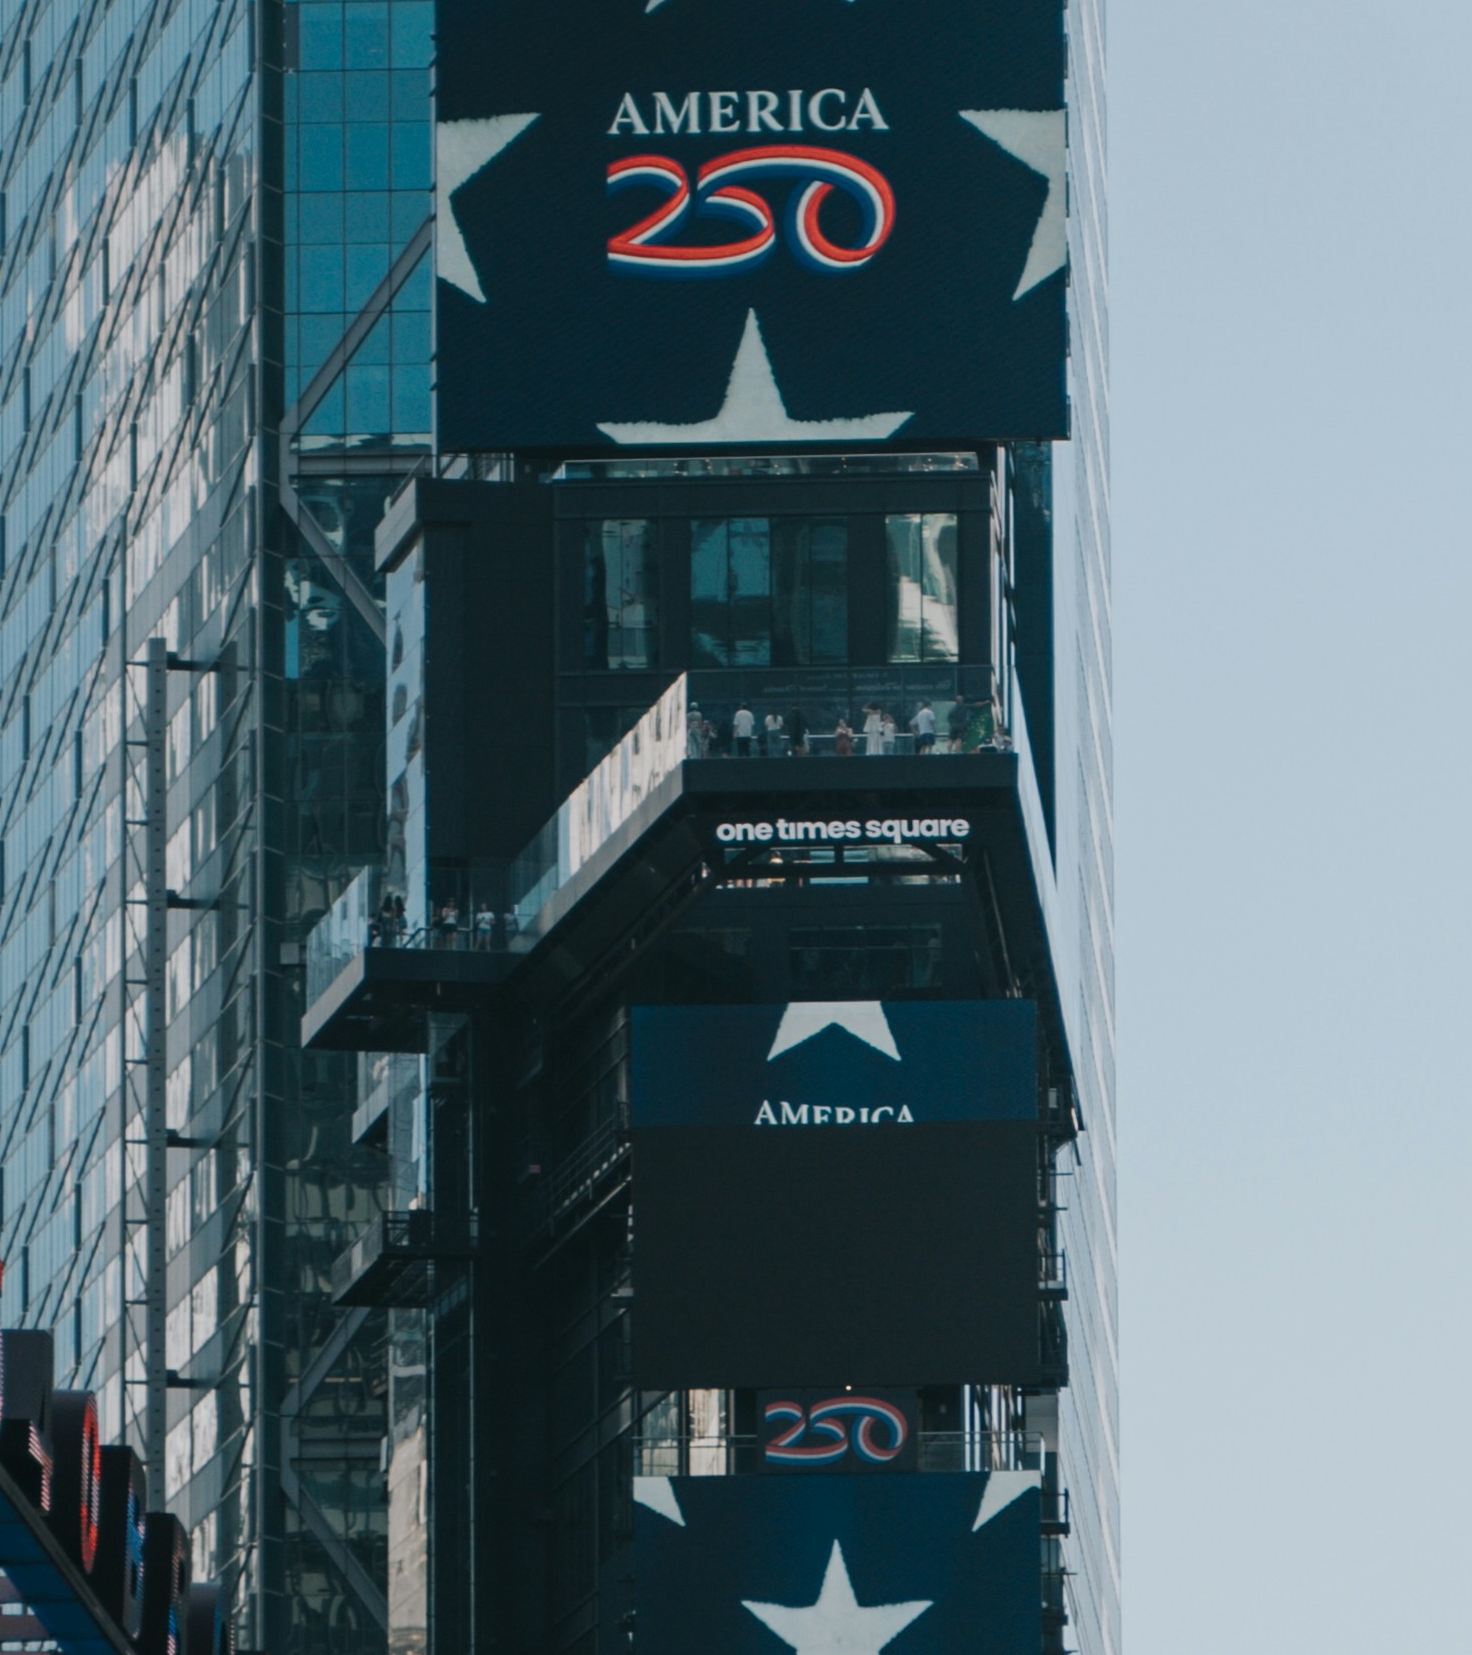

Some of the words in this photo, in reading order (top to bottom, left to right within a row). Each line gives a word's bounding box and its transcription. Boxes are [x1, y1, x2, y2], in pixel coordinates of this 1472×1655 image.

[606, 87, 891, 137] AMERICA
[606, 145, 898, 282] 250
[715, 817, 774, 843] one
[777, 815, 862, 842] times
[863, 813, 972, 846] square
[764, 1395, 911, 1467] 250
